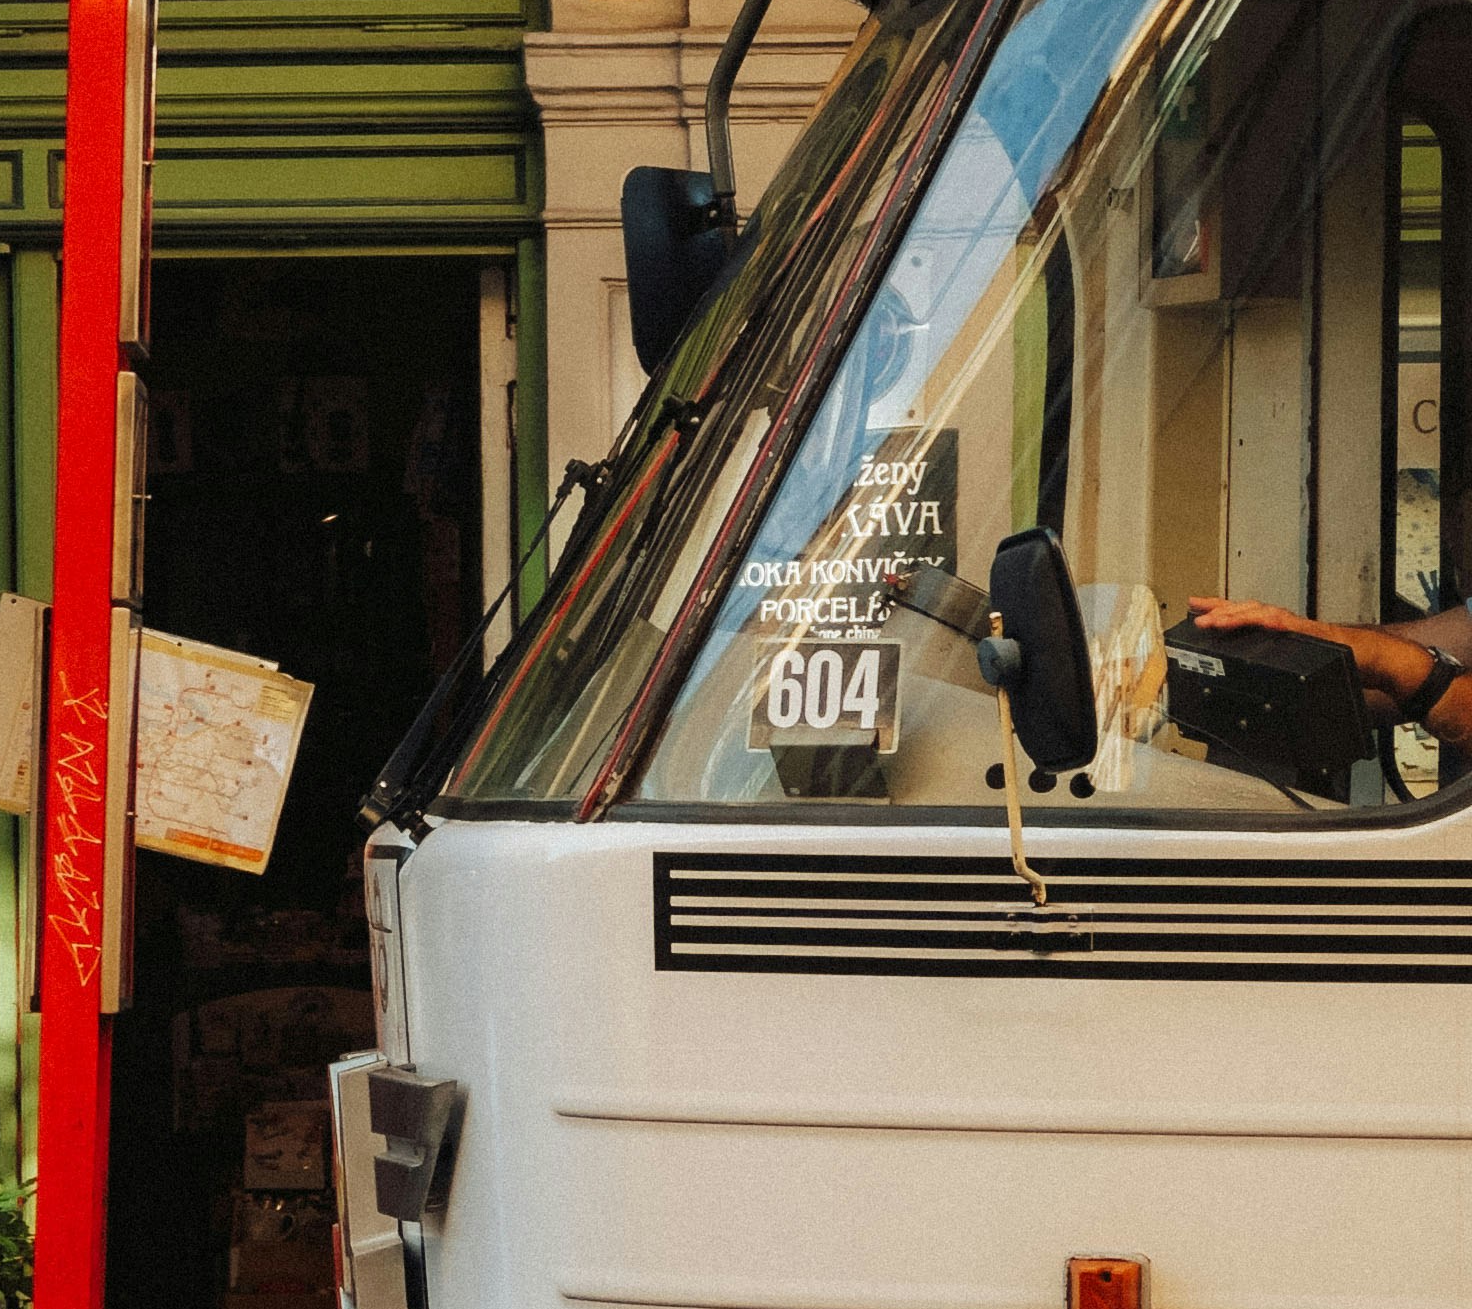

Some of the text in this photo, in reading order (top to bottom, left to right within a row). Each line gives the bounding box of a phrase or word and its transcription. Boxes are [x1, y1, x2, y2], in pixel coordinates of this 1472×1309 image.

[853, 452, 929, 496] žený
[739, 550, 945, 588] OKA KONVIČ
[767, 649, 881, 730] 604
